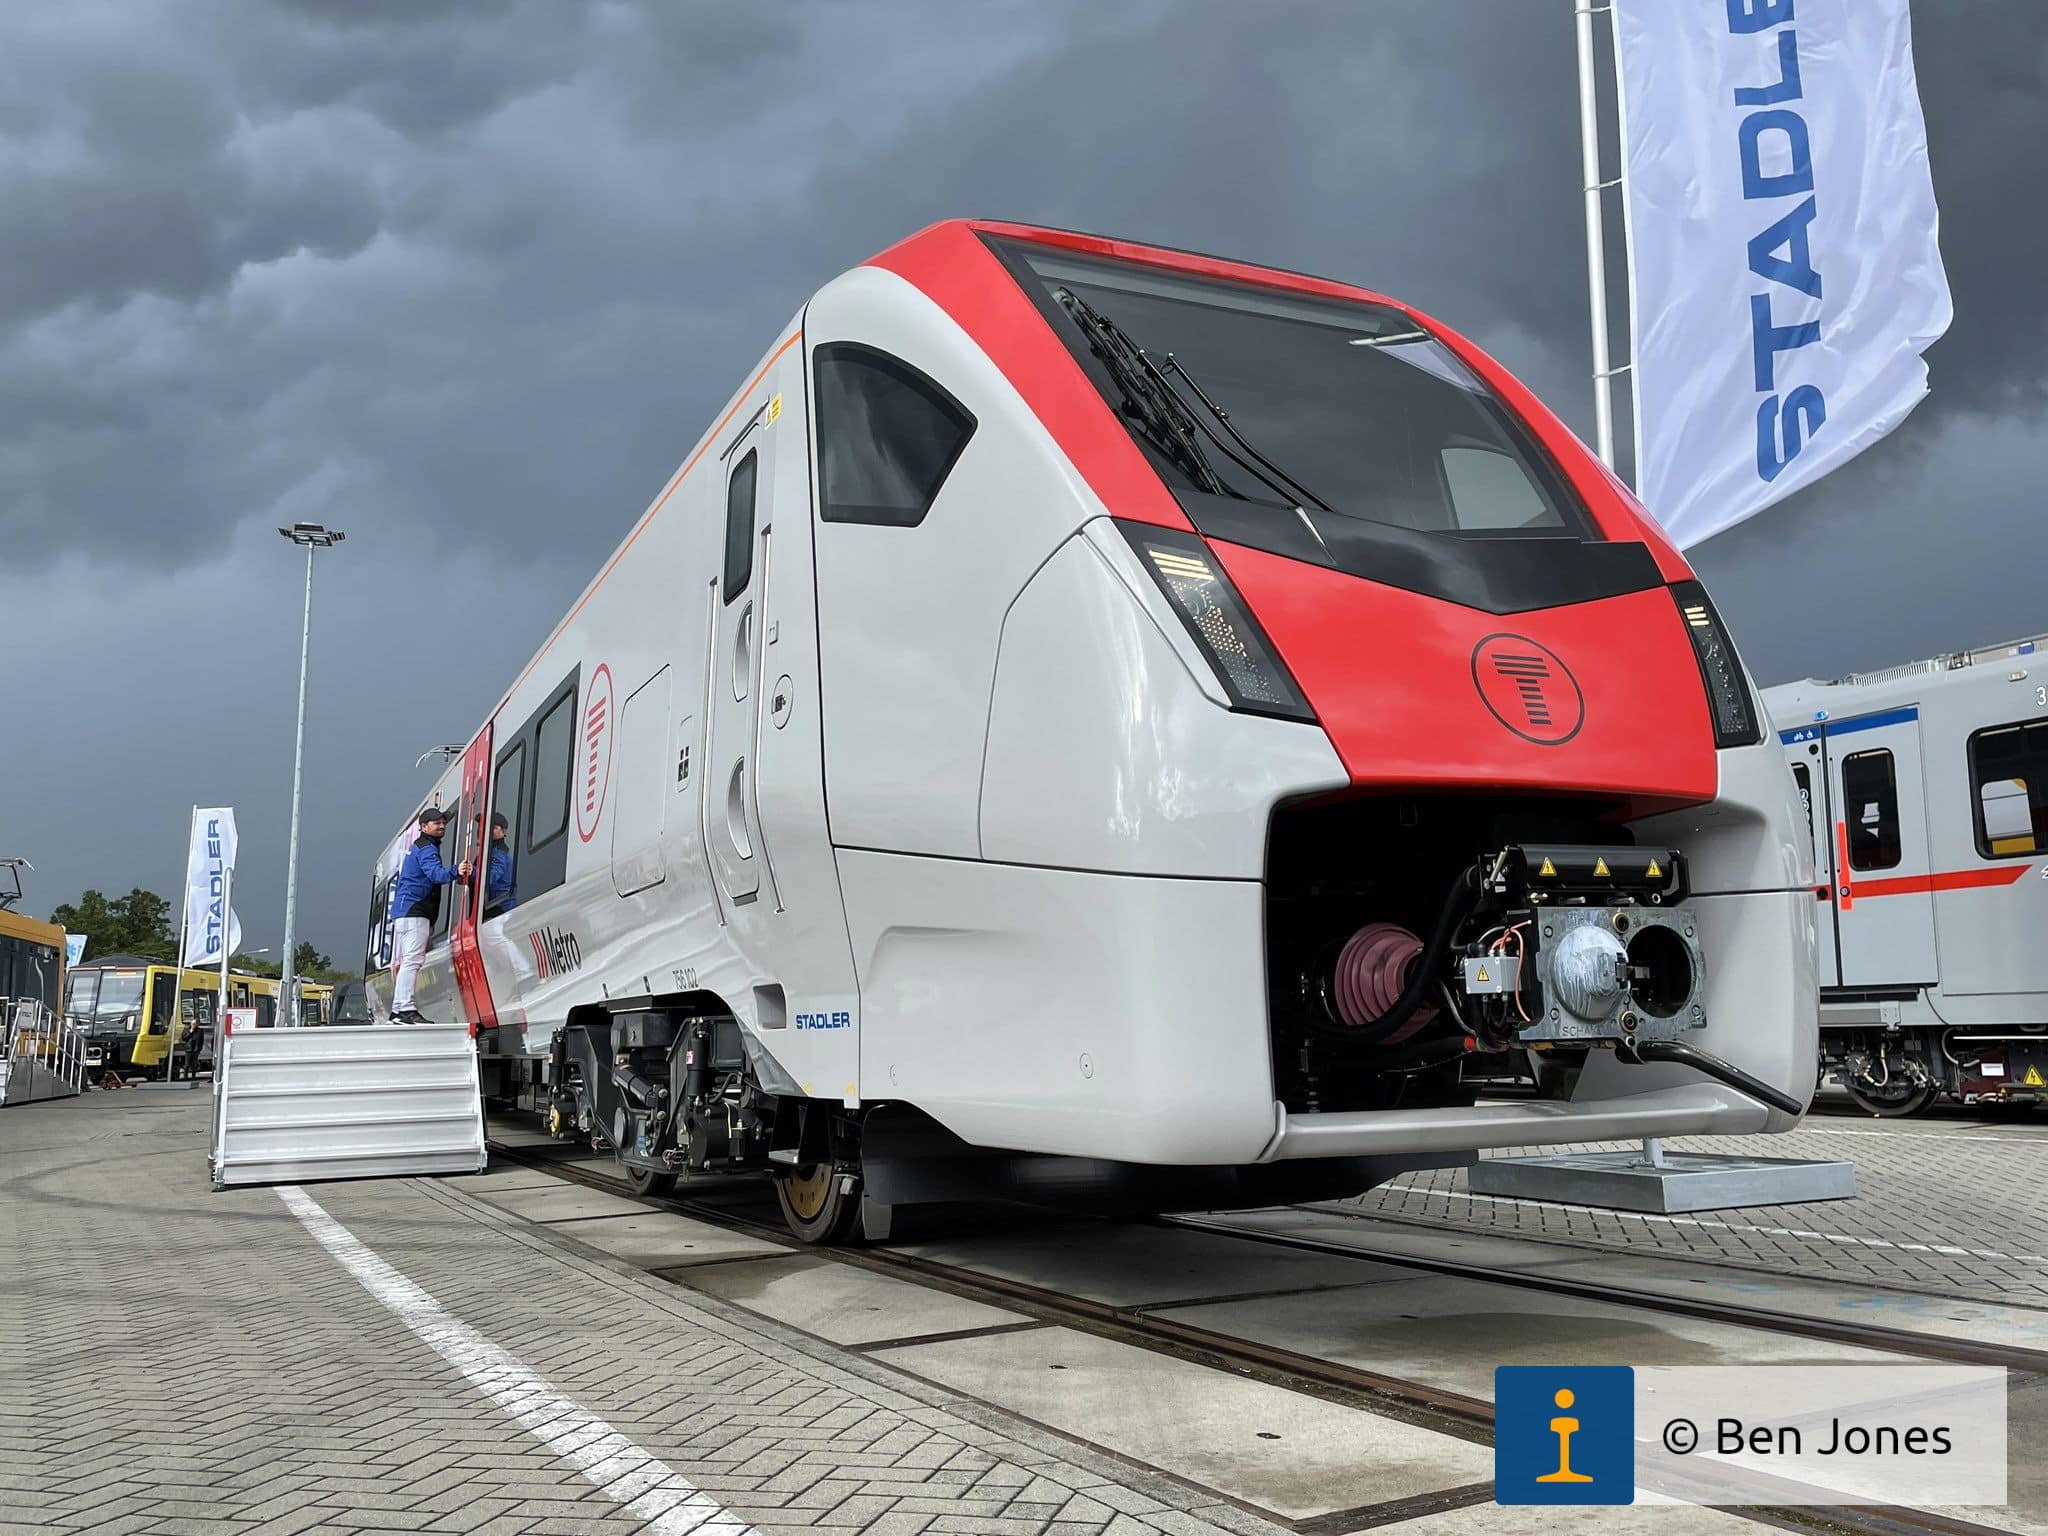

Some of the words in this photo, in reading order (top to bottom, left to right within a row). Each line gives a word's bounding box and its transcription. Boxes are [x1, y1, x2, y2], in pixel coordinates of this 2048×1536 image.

[206, 818, 223, 955] STADLER
[541, 926, 582, 976] Metro
[796, 1011, 850, 1030] STADLER
